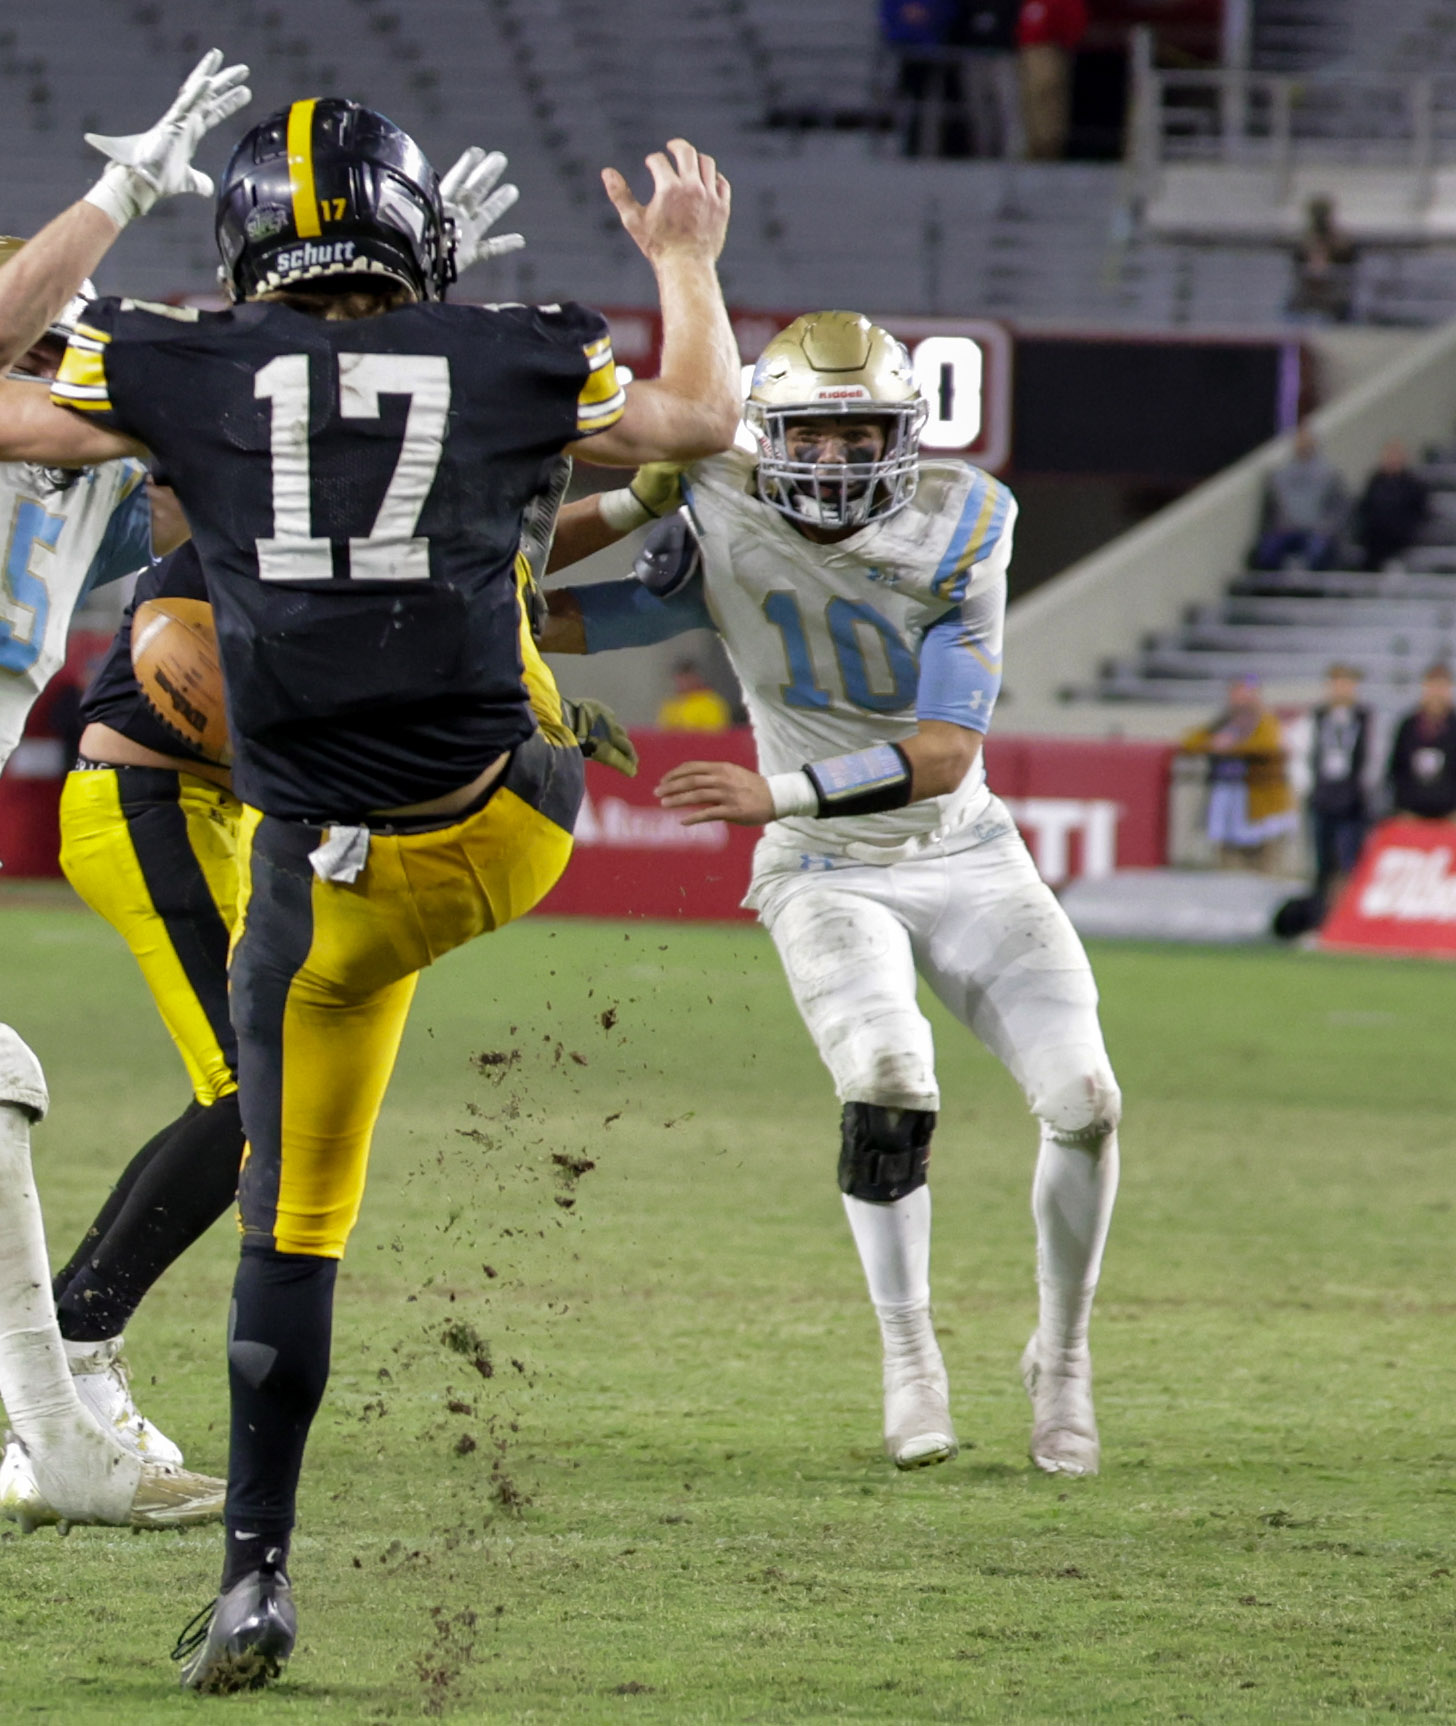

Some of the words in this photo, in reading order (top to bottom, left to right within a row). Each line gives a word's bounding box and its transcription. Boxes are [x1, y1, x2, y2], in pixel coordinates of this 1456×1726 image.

[276, 240, 357, 273] schutt
[320, 198, 347, 222] 17
[913, 336, 982, 449] 0
[253, 352, 451, 581] 17
[761, 589, 921, 715] 10
